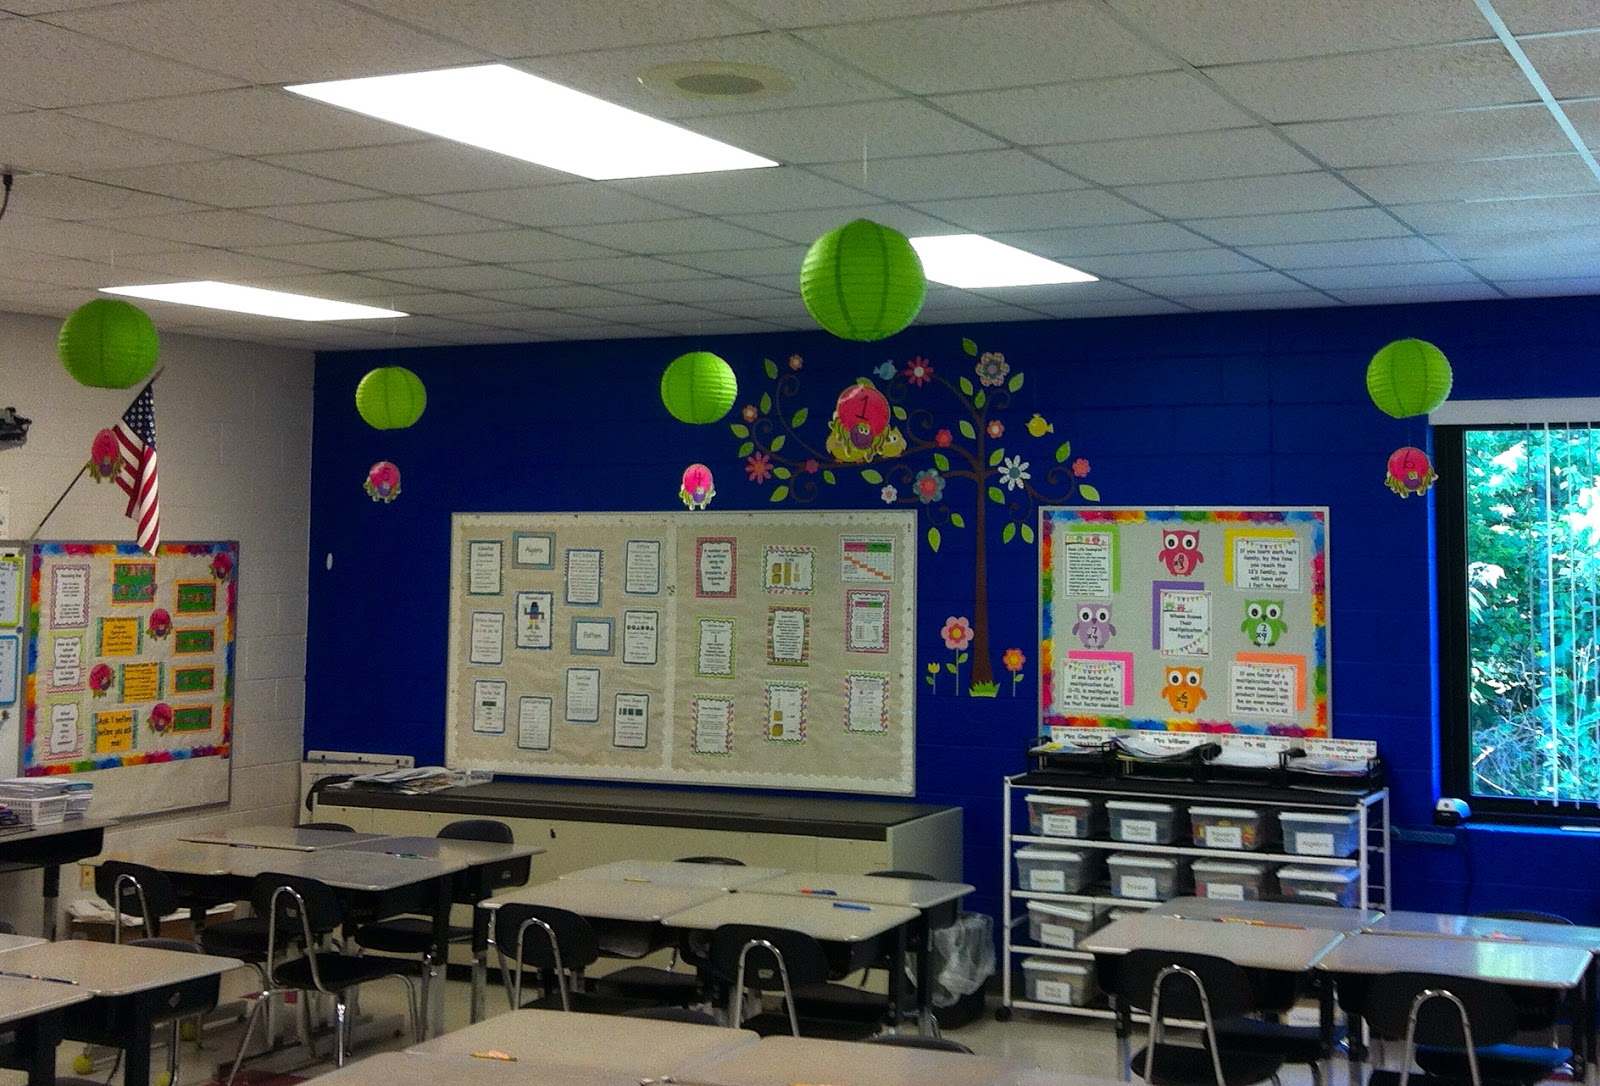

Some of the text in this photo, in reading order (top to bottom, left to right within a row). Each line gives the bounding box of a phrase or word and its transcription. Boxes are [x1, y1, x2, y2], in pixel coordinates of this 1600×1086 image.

[855, 395, 869, 421] 1
[1402, 450, 1415, 469] 6
[1077, 733, 1102, 742] Courtney
